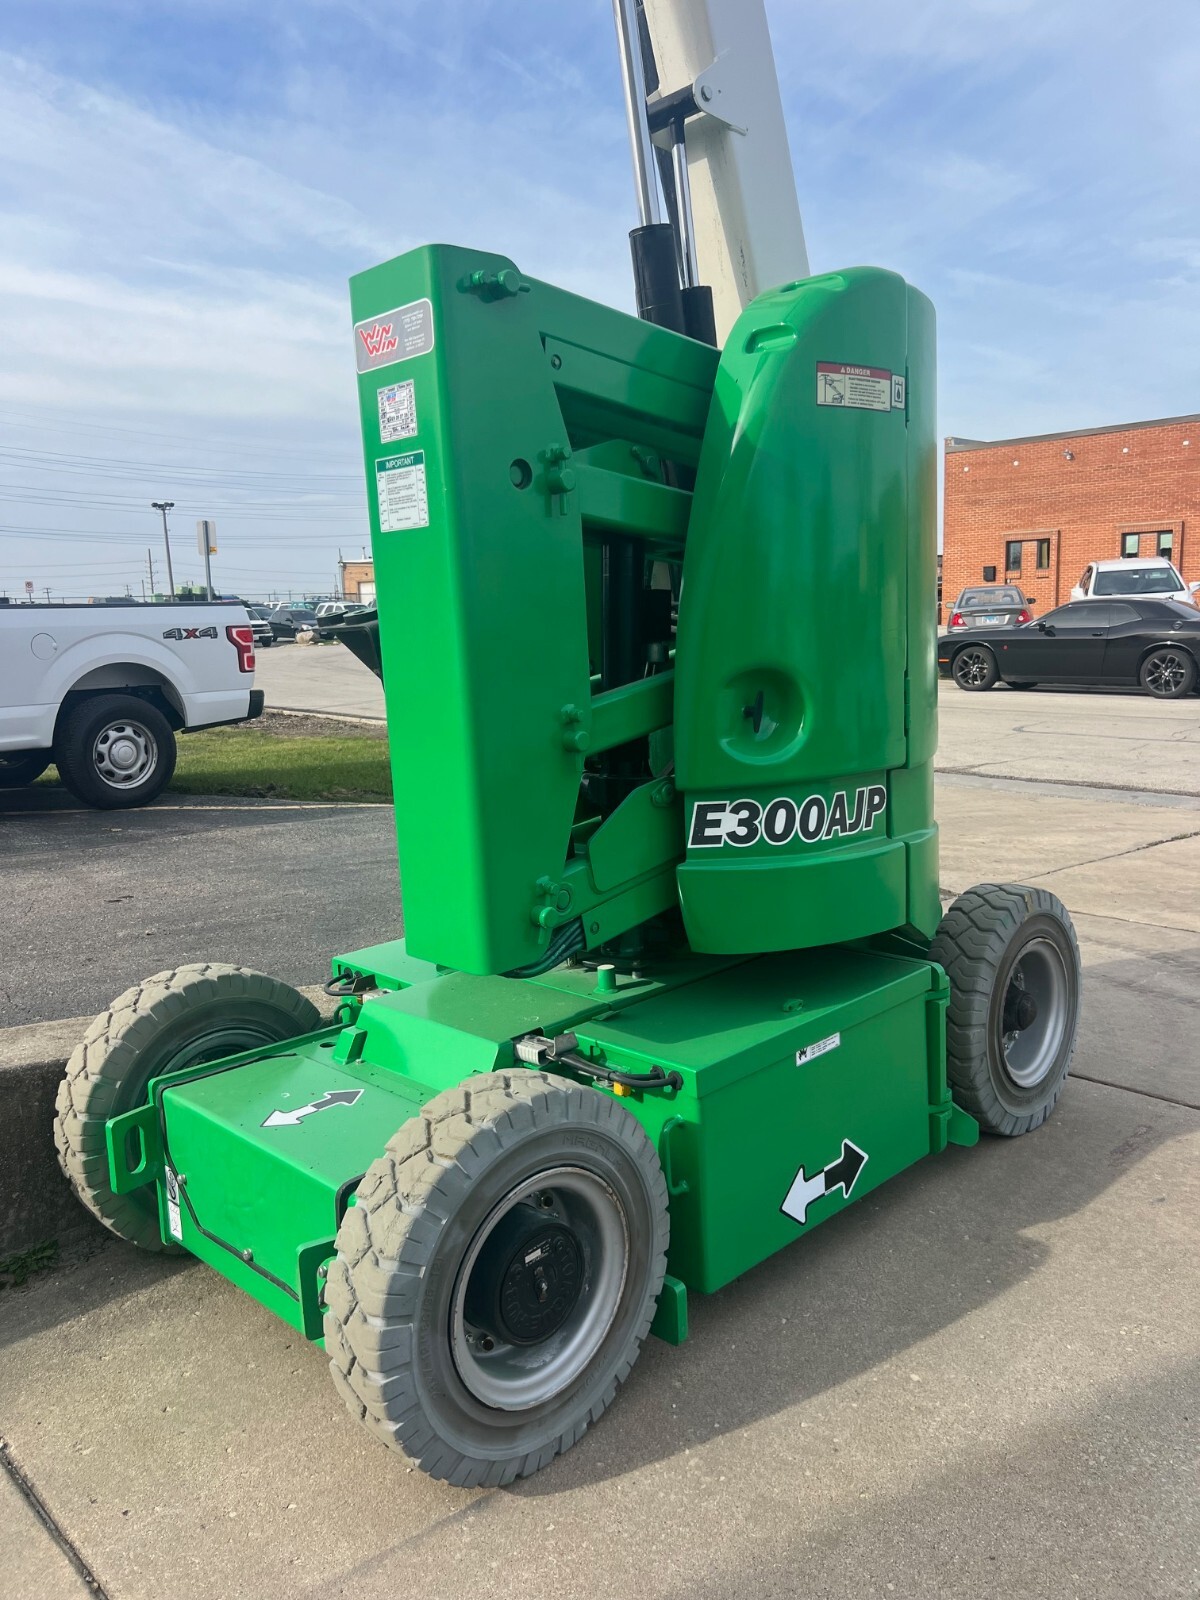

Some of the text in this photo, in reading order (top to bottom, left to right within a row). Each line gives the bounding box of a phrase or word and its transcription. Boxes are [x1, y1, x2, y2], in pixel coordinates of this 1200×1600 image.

[359, 323, 393, 342] WIN
[363, 336, 398, 357] WIN
[846, 366, 871, 377] DANGER
[385, 456, 414, 469] IMPORTANT
[687, 785, 886, 848] E300AJP
